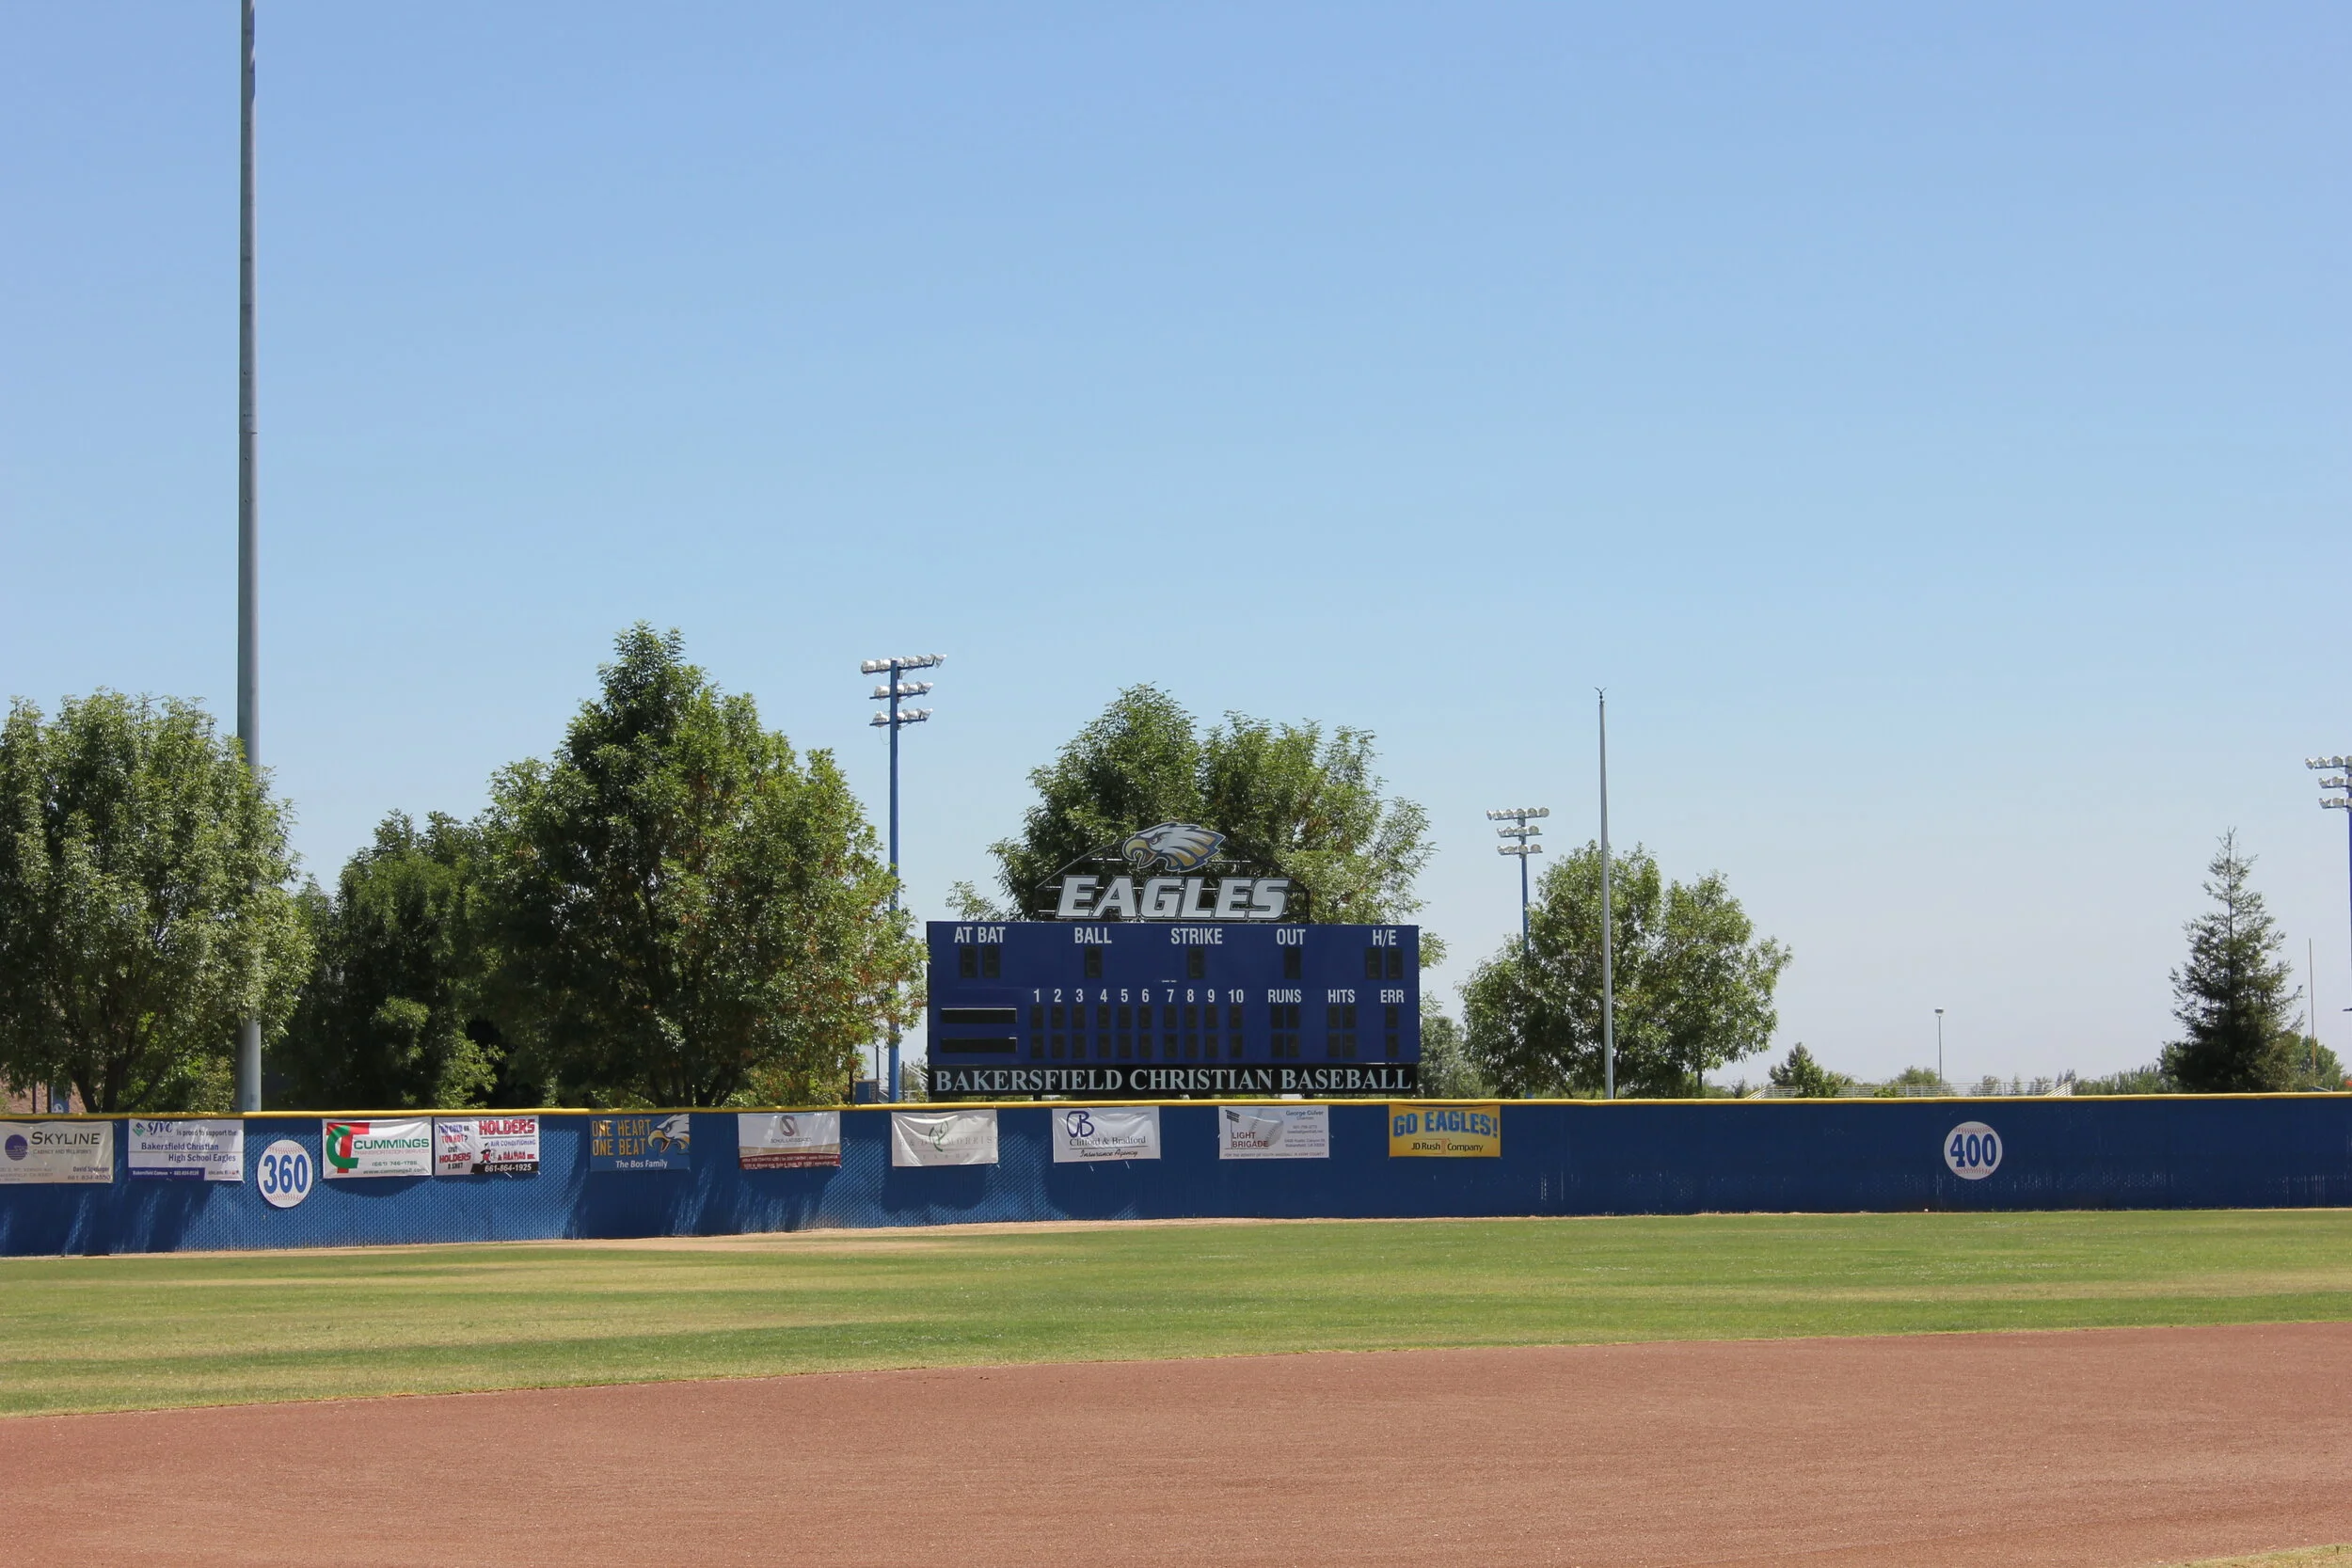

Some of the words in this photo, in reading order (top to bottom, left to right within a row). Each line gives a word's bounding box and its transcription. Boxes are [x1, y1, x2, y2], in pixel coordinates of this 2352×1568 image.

[1056, 874, 1292, 920] EAGLES
[954, 927, 973, 943] AT
[977, 927, 1006, 943] BAT
[1074, 927, 1112, 944] BALL
[1170, 927, 1223, 944] STRIKE
[1277, 928, 1306, 945] OUT
[1372, 929, 1397, 946] H/E
[1033, 989, 1041, 1003] 1
[1054, 989, 1062, 1003] 2
[1075, 989, 1084, 1003] 3
[1100, 989, 1108, 1003] 4
[1120, 989, 1128, 1003] 5
[1141, 989, 1150, 1003] 6
[1167, 989, 1174, 1003] 7
[1186, 989, 1195, 1003] 8
[1207, 989, 1216, 1003] 9
[1228, 989, 1245, 1003] 10
[1267, 990, 1302, 1004] RUNS
[1327, 990, 1356, 1003] HITS
[1380, 990, 1405, 1003] ERR
[934, 1069, 1123, 1091] BAKERSFIELD
[1130, 1069, 1273, 1090] CHRISTIAN
[1280, 1069, 1411, 1089] BASEBALL
[147, 1121, 173, 1135] SJVC
[478, 1119, 535, 1135] HOLDERS
[592, 1120, 612, 1137] ONE
[617, 1119, 651, 1136] HEART
[1392, 1113, 1418, 1137] GO
[1424, 1111, 1498, 1139] EAGLES!
[31, 1132, 101, 1145] SKYLINE
[354, 1138, 430, 1149] CUMMINGS
[1069, 1137, 1101, 1147] Clifford
[1112, 1135, 1146, 1145] Bradford
[1232, 1132, 1256, 1140] LIGHT
[141, 1142, 185, 1150] Bakersfield
[186, 1142, 219, 1150] Christian
[593, 1139, 614, 1156] ONE
[618, 1138, 646, 1155] BEAT
[1079, 1149, 1113, 1158] Insurance
[1114, 1148, 1138, 1159] Agency
[1447, 1143, 1484, 1152] Company
[1949, 1132, 1997, 1167] 400
[168, 1154, 186, 1164] High
[213, 1154, 236, 1164] Eagles
[439, 1152, 471, 1164] HOLDERS
[615, 1160, 629, 1168] The
[630, 1160, 644, 1168] Bos
[644, 1159, 668, 1169] Family
[263, 1154, 308, 1194] 360
